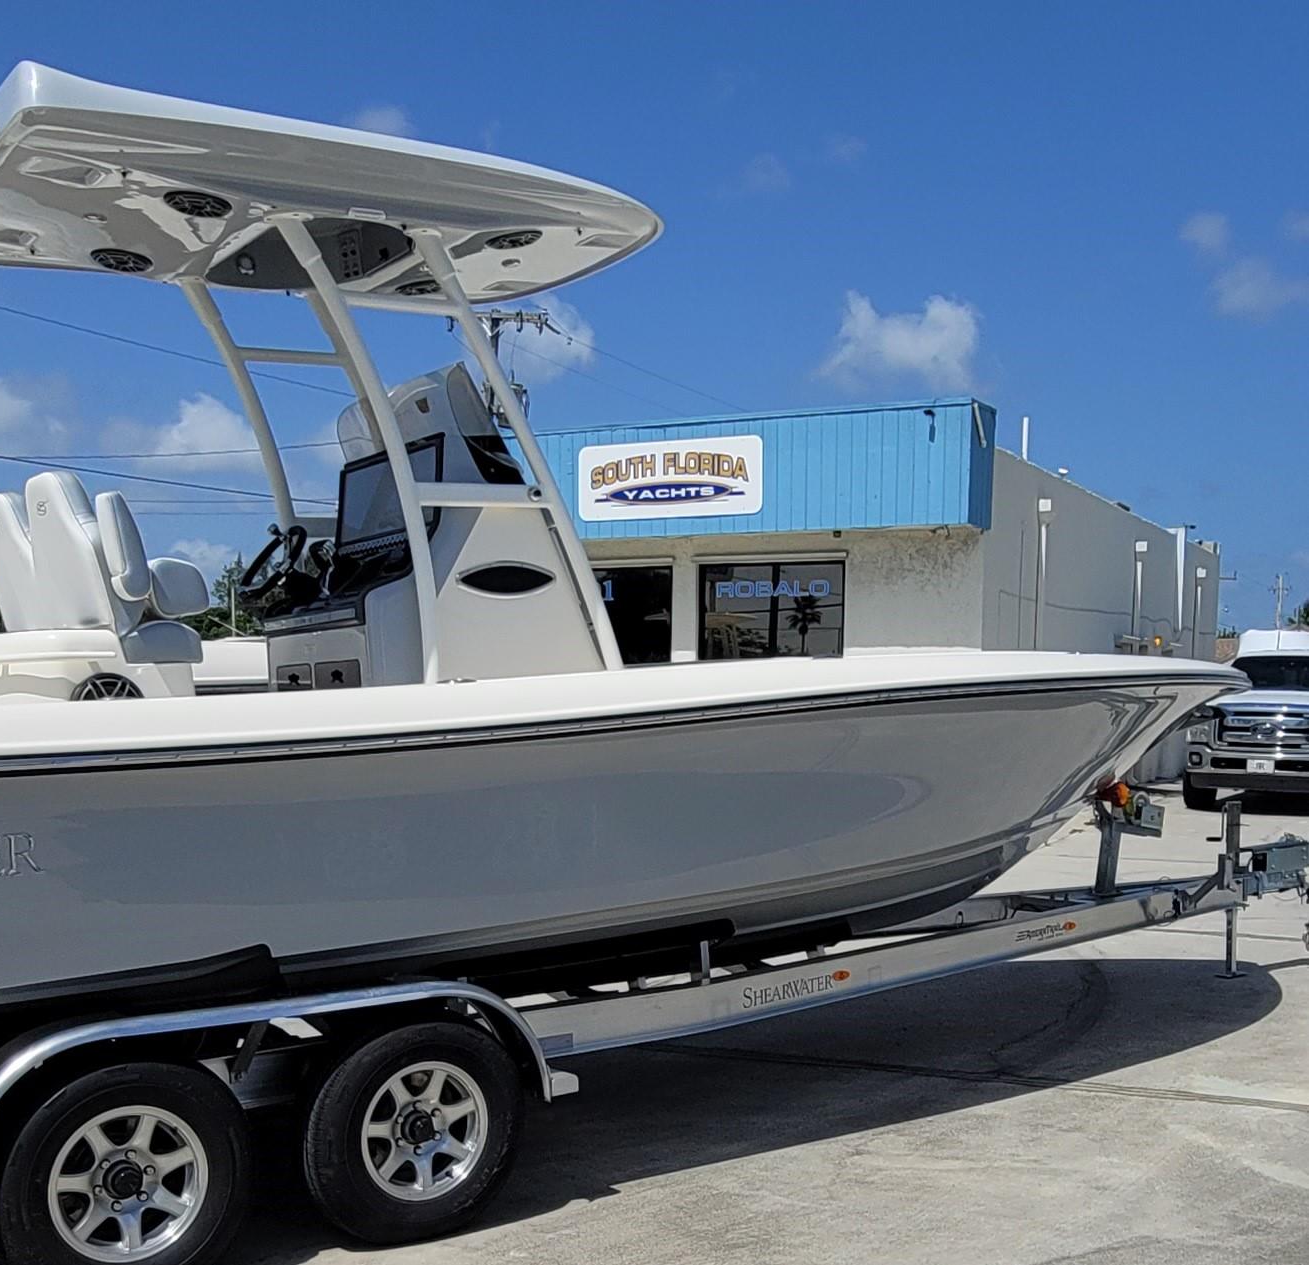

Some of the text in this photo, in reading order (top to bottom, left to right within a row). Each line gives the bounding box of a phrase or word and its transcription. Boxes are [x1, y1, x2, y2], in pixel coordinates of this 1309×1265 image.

[590, 451, 749, 489] SOUTH FLORIDA
[623, 486, 715, 500] YACHTS
[715, 579, 830, 598] ROBALO
